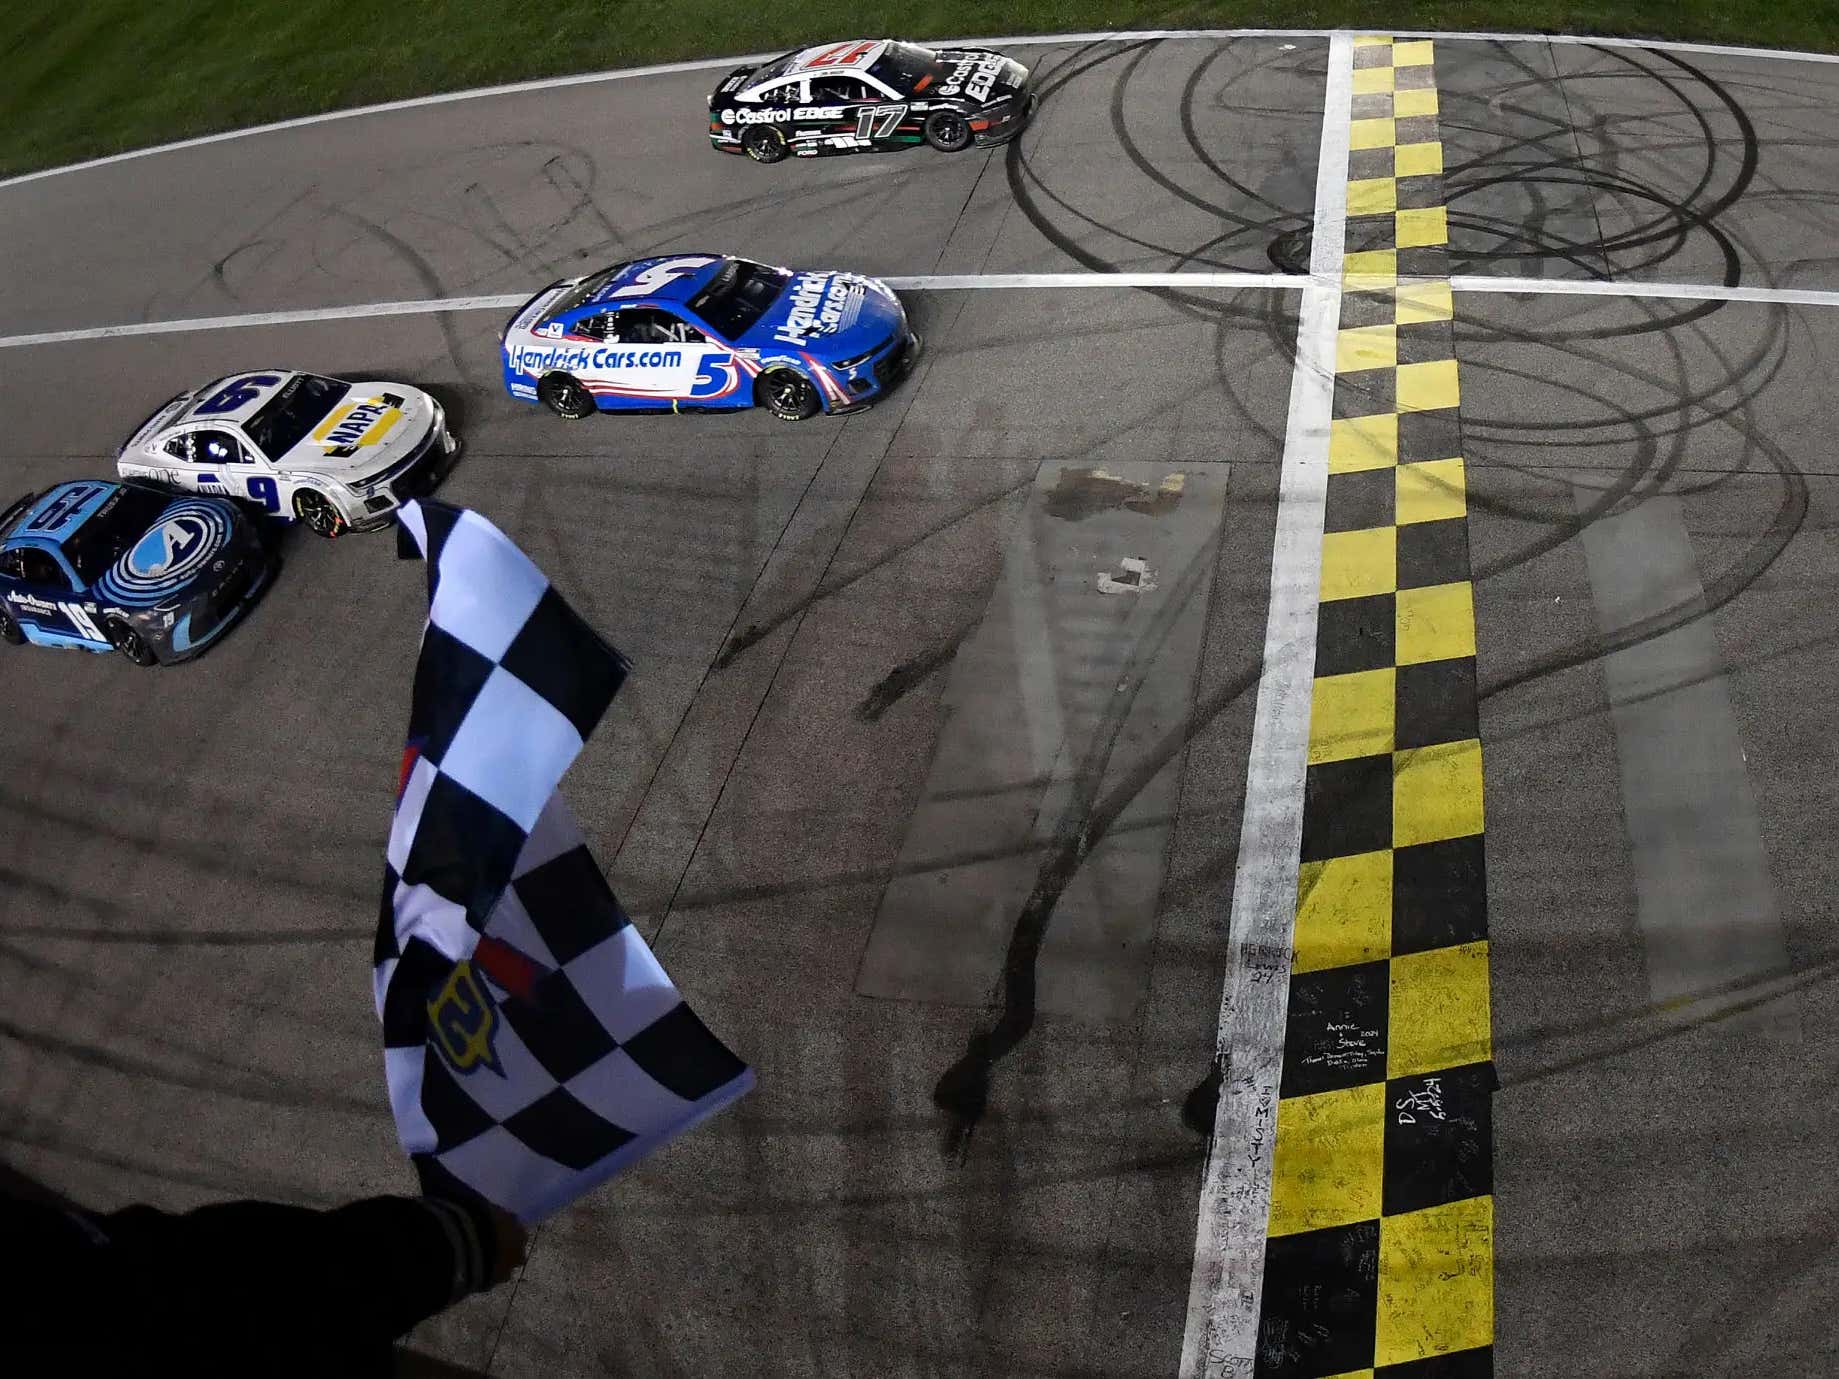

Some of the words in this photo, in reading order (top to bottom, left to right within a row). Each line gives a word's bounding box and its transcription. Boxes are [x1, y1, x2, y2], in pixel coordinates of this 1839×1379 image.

[802, 42, 879, 69] 17
[735, 107, 791, 124] Castrol
[793, 107, 844, 120] EDGE
[856, 105, 907, 139] 17
[609, 257, 717, 298] 5
[774, 271, 830, 346] Hendrick
[690, 353, 732, 396] 5
[193, 375, 282, 415] 9
[326, 404, 388, 443] NAPA
[246, 476, 281, 513] 9
[58, 601, 108, 642] 19
